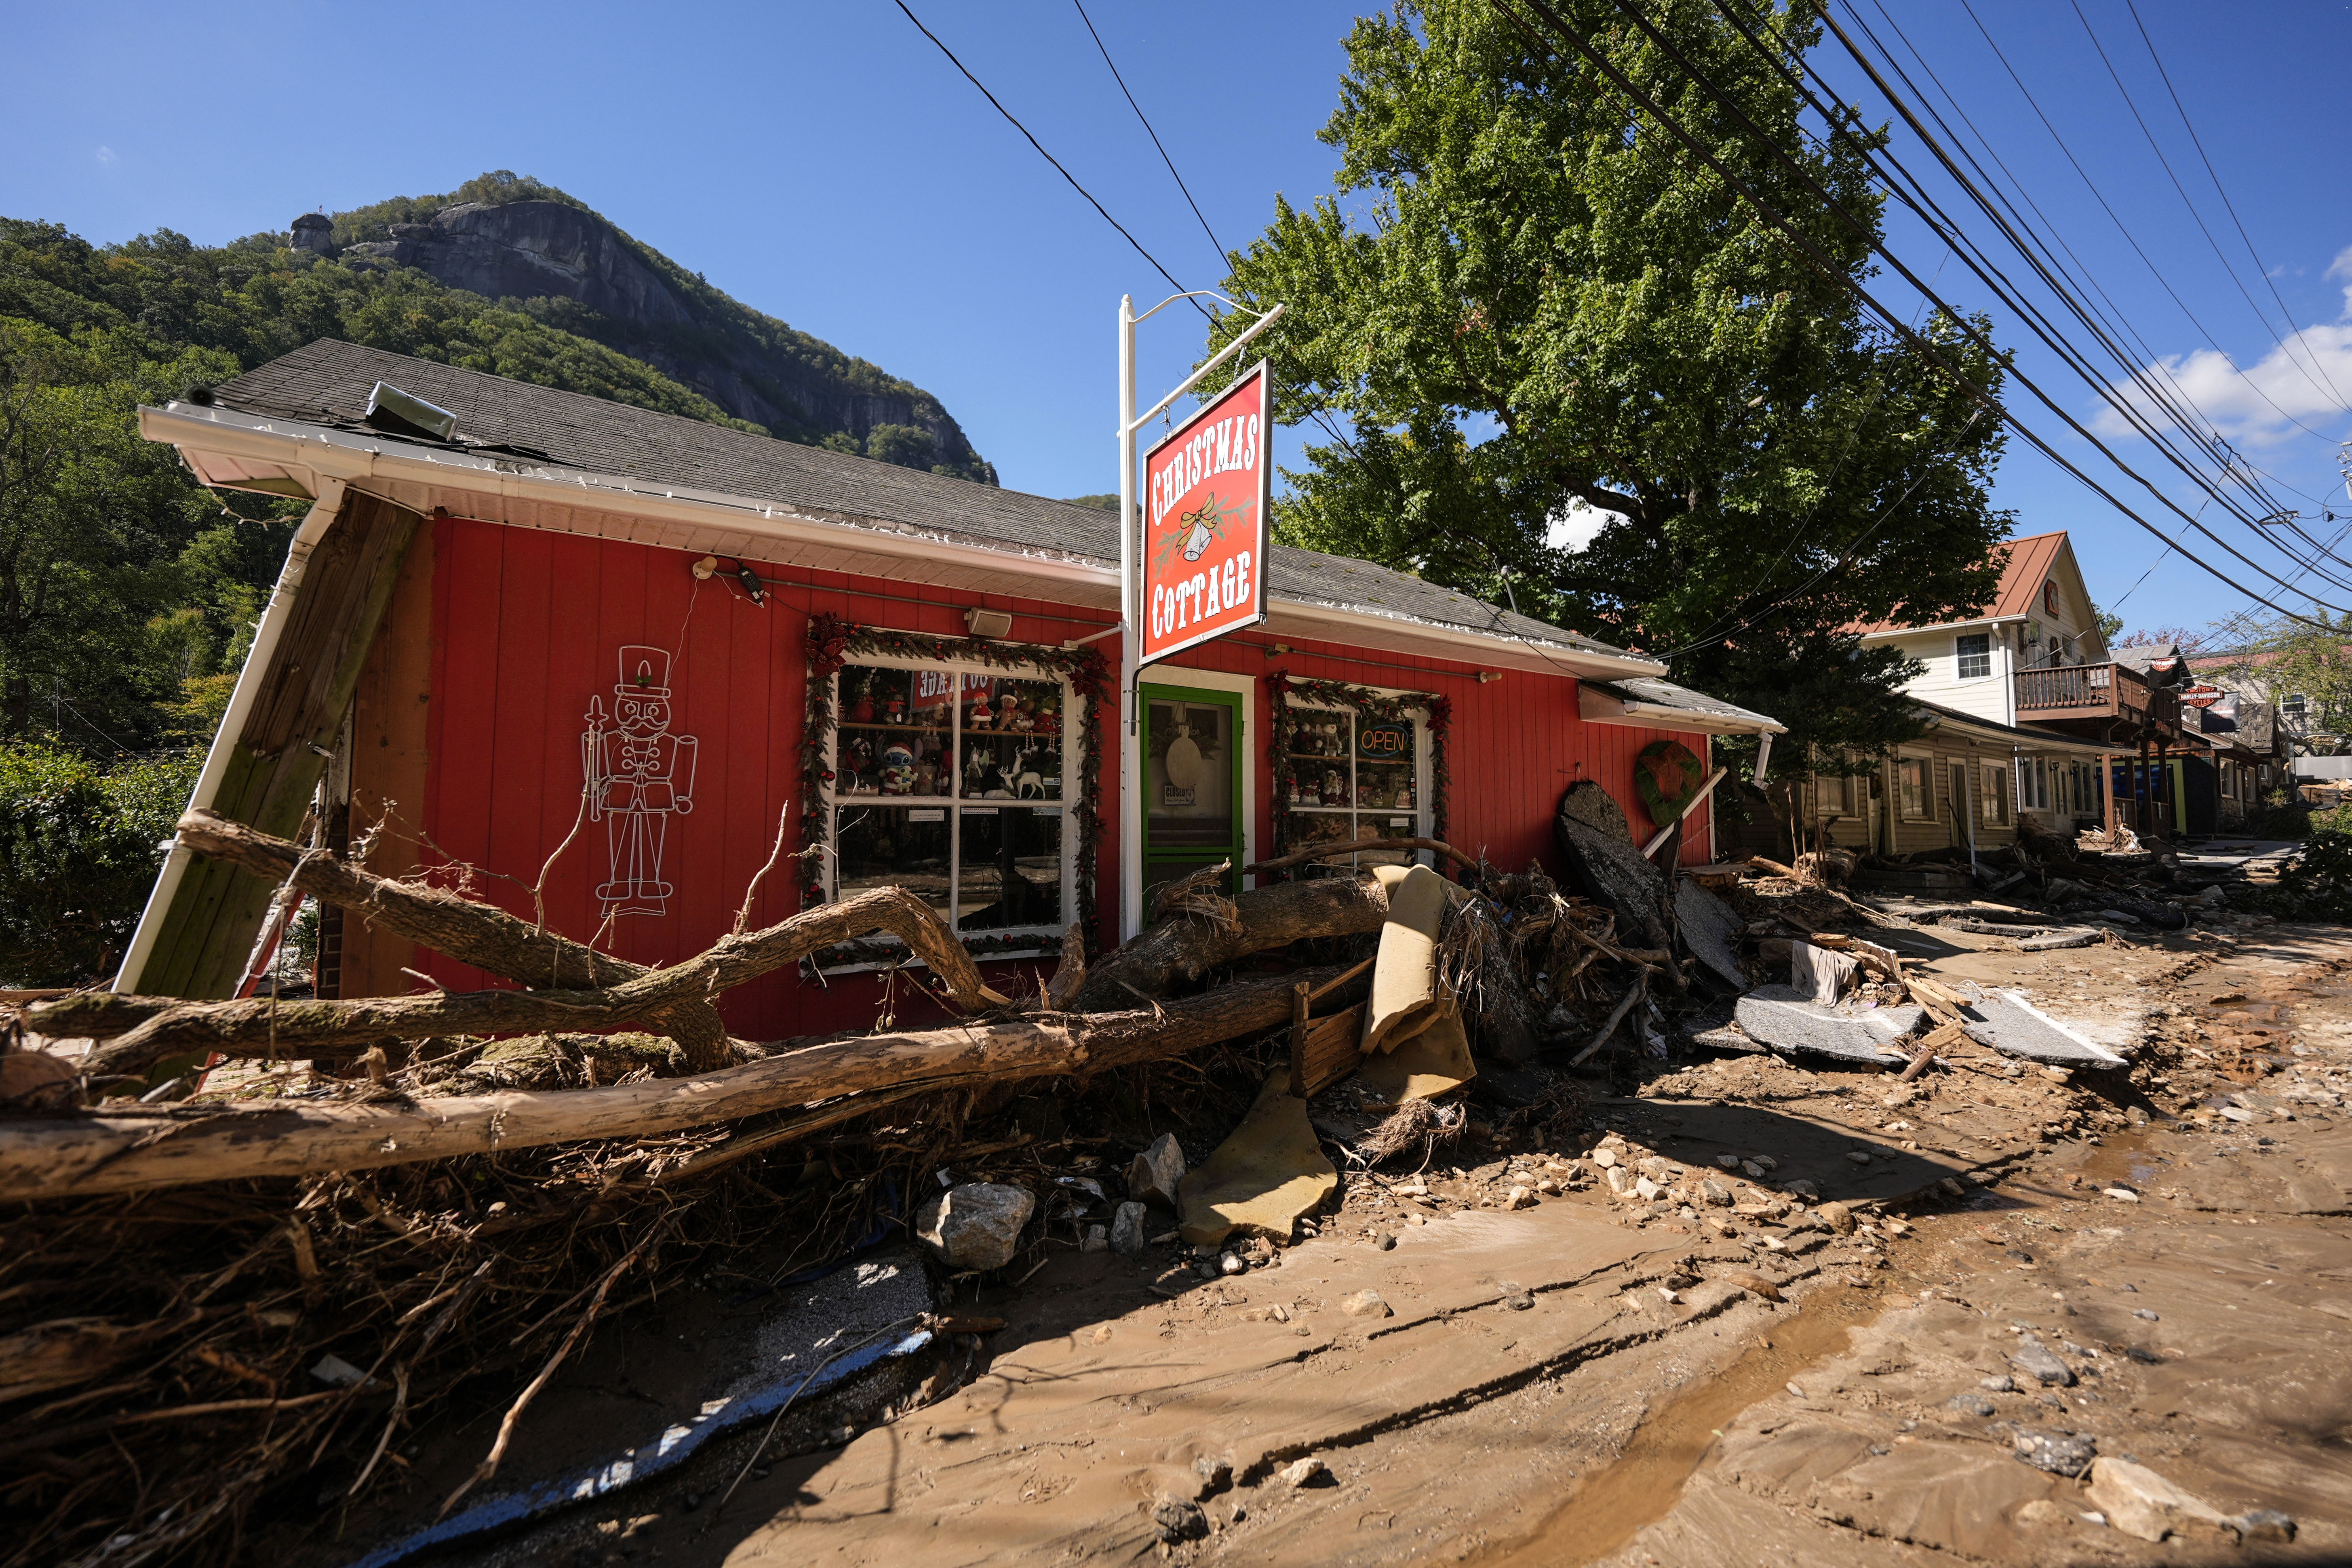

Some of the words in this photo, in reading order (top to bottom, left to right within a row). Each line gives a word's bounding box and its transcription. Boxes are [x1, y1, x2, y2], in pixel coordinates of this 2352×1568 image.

[1152, 413, 1258, 526] CHRISTMAS
[1152, 550, 1251, 639] COTTAGE
[1361, 730, 1404, 751] OPEN
[1166, 787, 1185, 797] CLOSED
